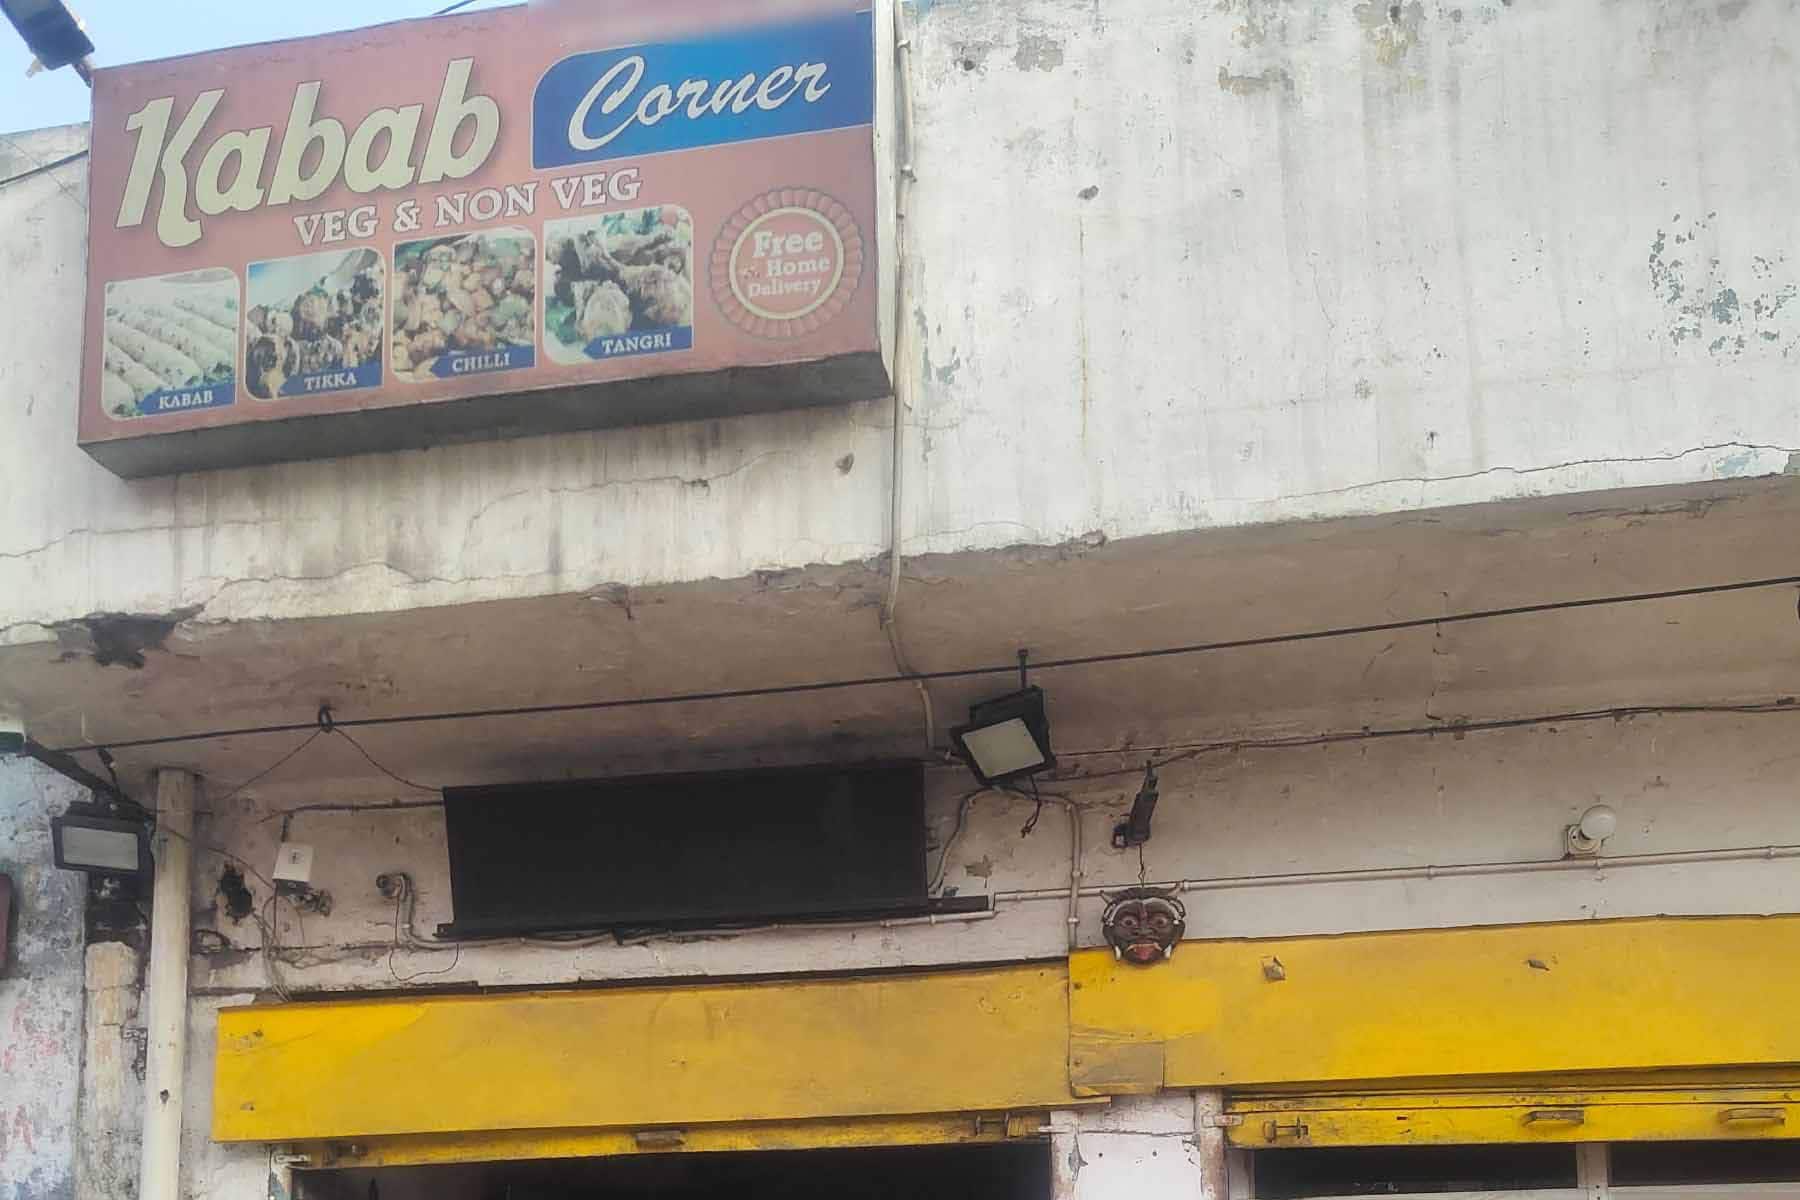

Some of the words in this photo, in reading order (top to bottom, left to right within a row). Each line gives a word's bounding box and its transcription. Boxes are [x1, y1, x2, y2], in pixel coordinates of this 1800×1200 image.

[115, 57, 500, 248] Kabab
[568, 54, 831, 152] Corner
[294, 204, 379, 246] VEG
[392, 199, 421, 233] &
[434, 181, 540, 228] NON
[550, 168, 642, 210] VEG
[753, 230, 824, 257] Free
[766, 256, 831, 277] Home
[601, 332, 672, 355] TANGRI
[452, 352, 511, 373] CHILLI
[304, 372, 358, 391] TIKKA
[159, 390, 213, 410] KABAB
